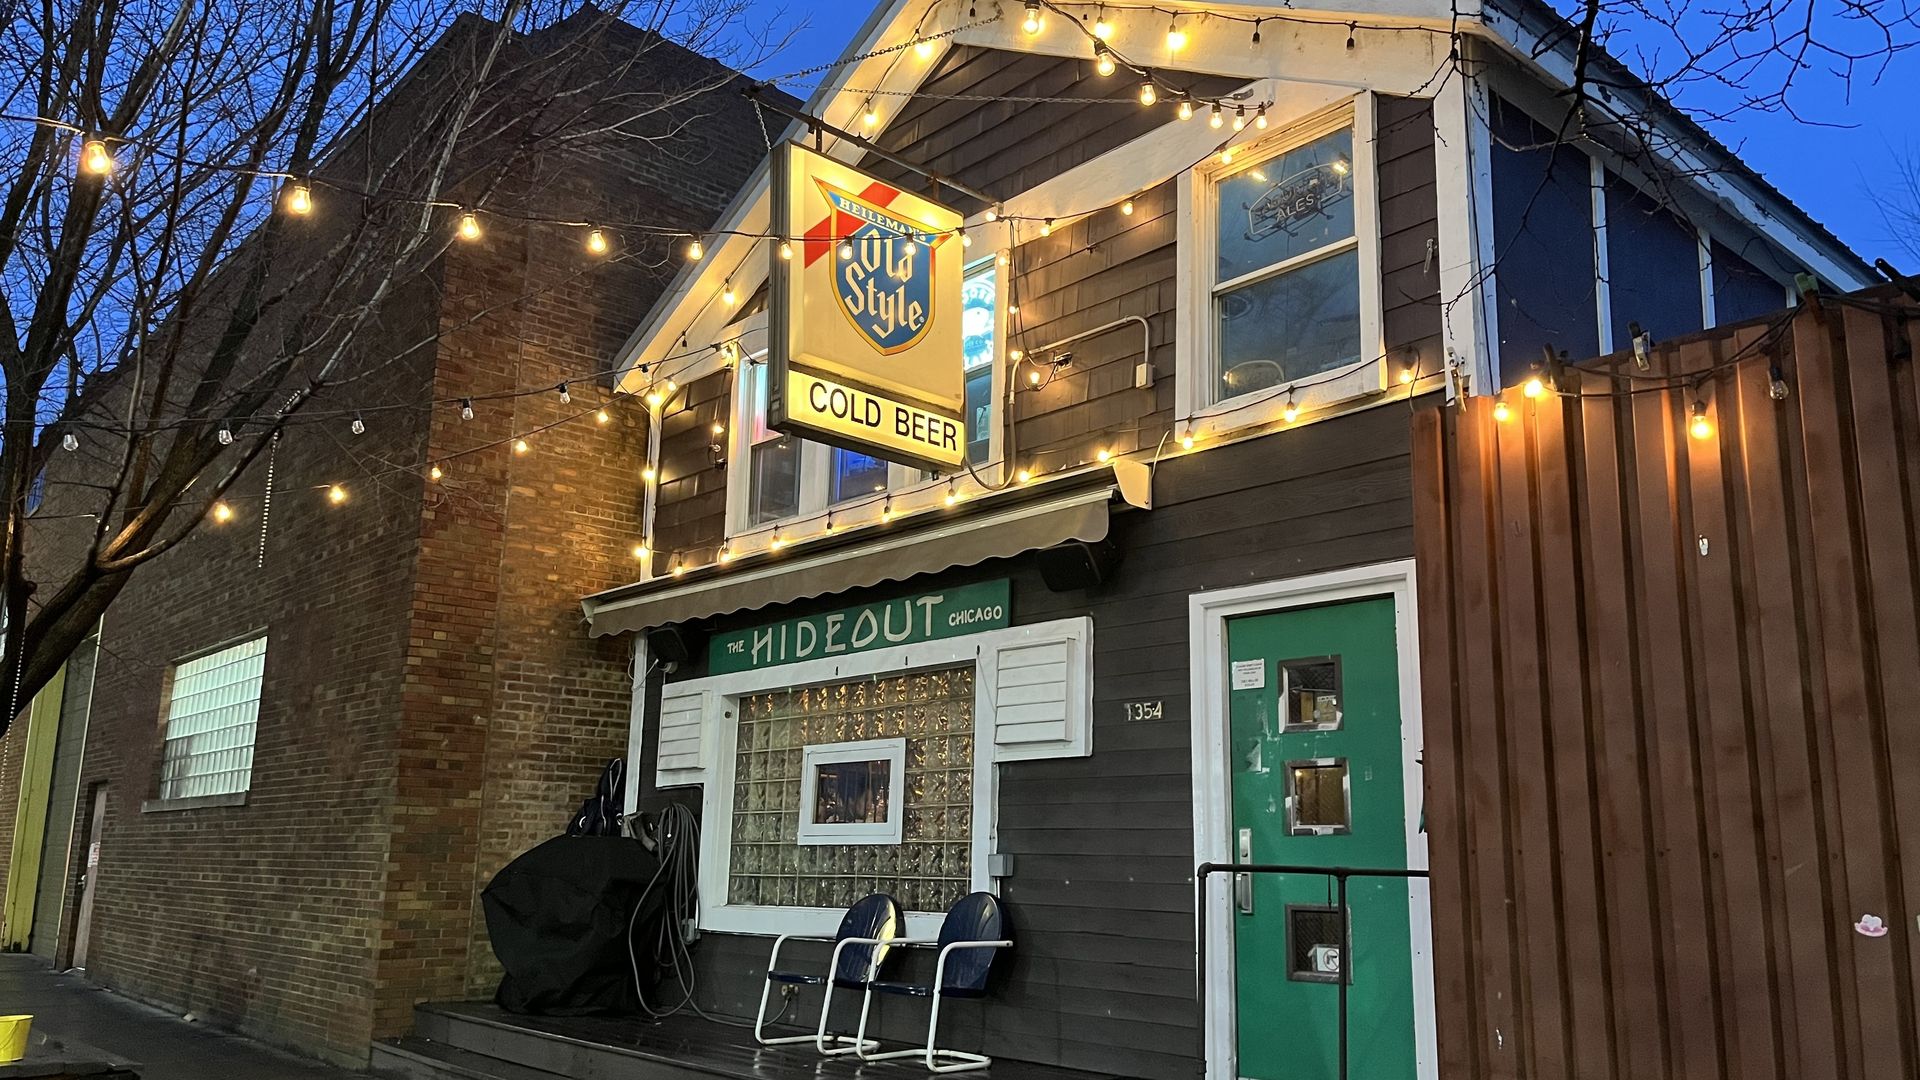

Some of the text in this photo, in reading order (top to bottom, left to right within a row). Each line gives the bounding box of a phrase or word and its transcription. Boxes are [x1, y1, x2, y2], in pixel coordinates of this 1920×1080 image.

[839, 197, 927, 241] HEILEMAN'S
[1276, 194, 1314, 222] ALES
[860, 228, 914, 283] Old
[844, 262, 923, 339] Style
[809, 381, 957, 451] COLD BEER
[727, 594, 1002, 665] THE HIDEOUT CHICAGO
[1123, 701, 1163, 721] 1354
